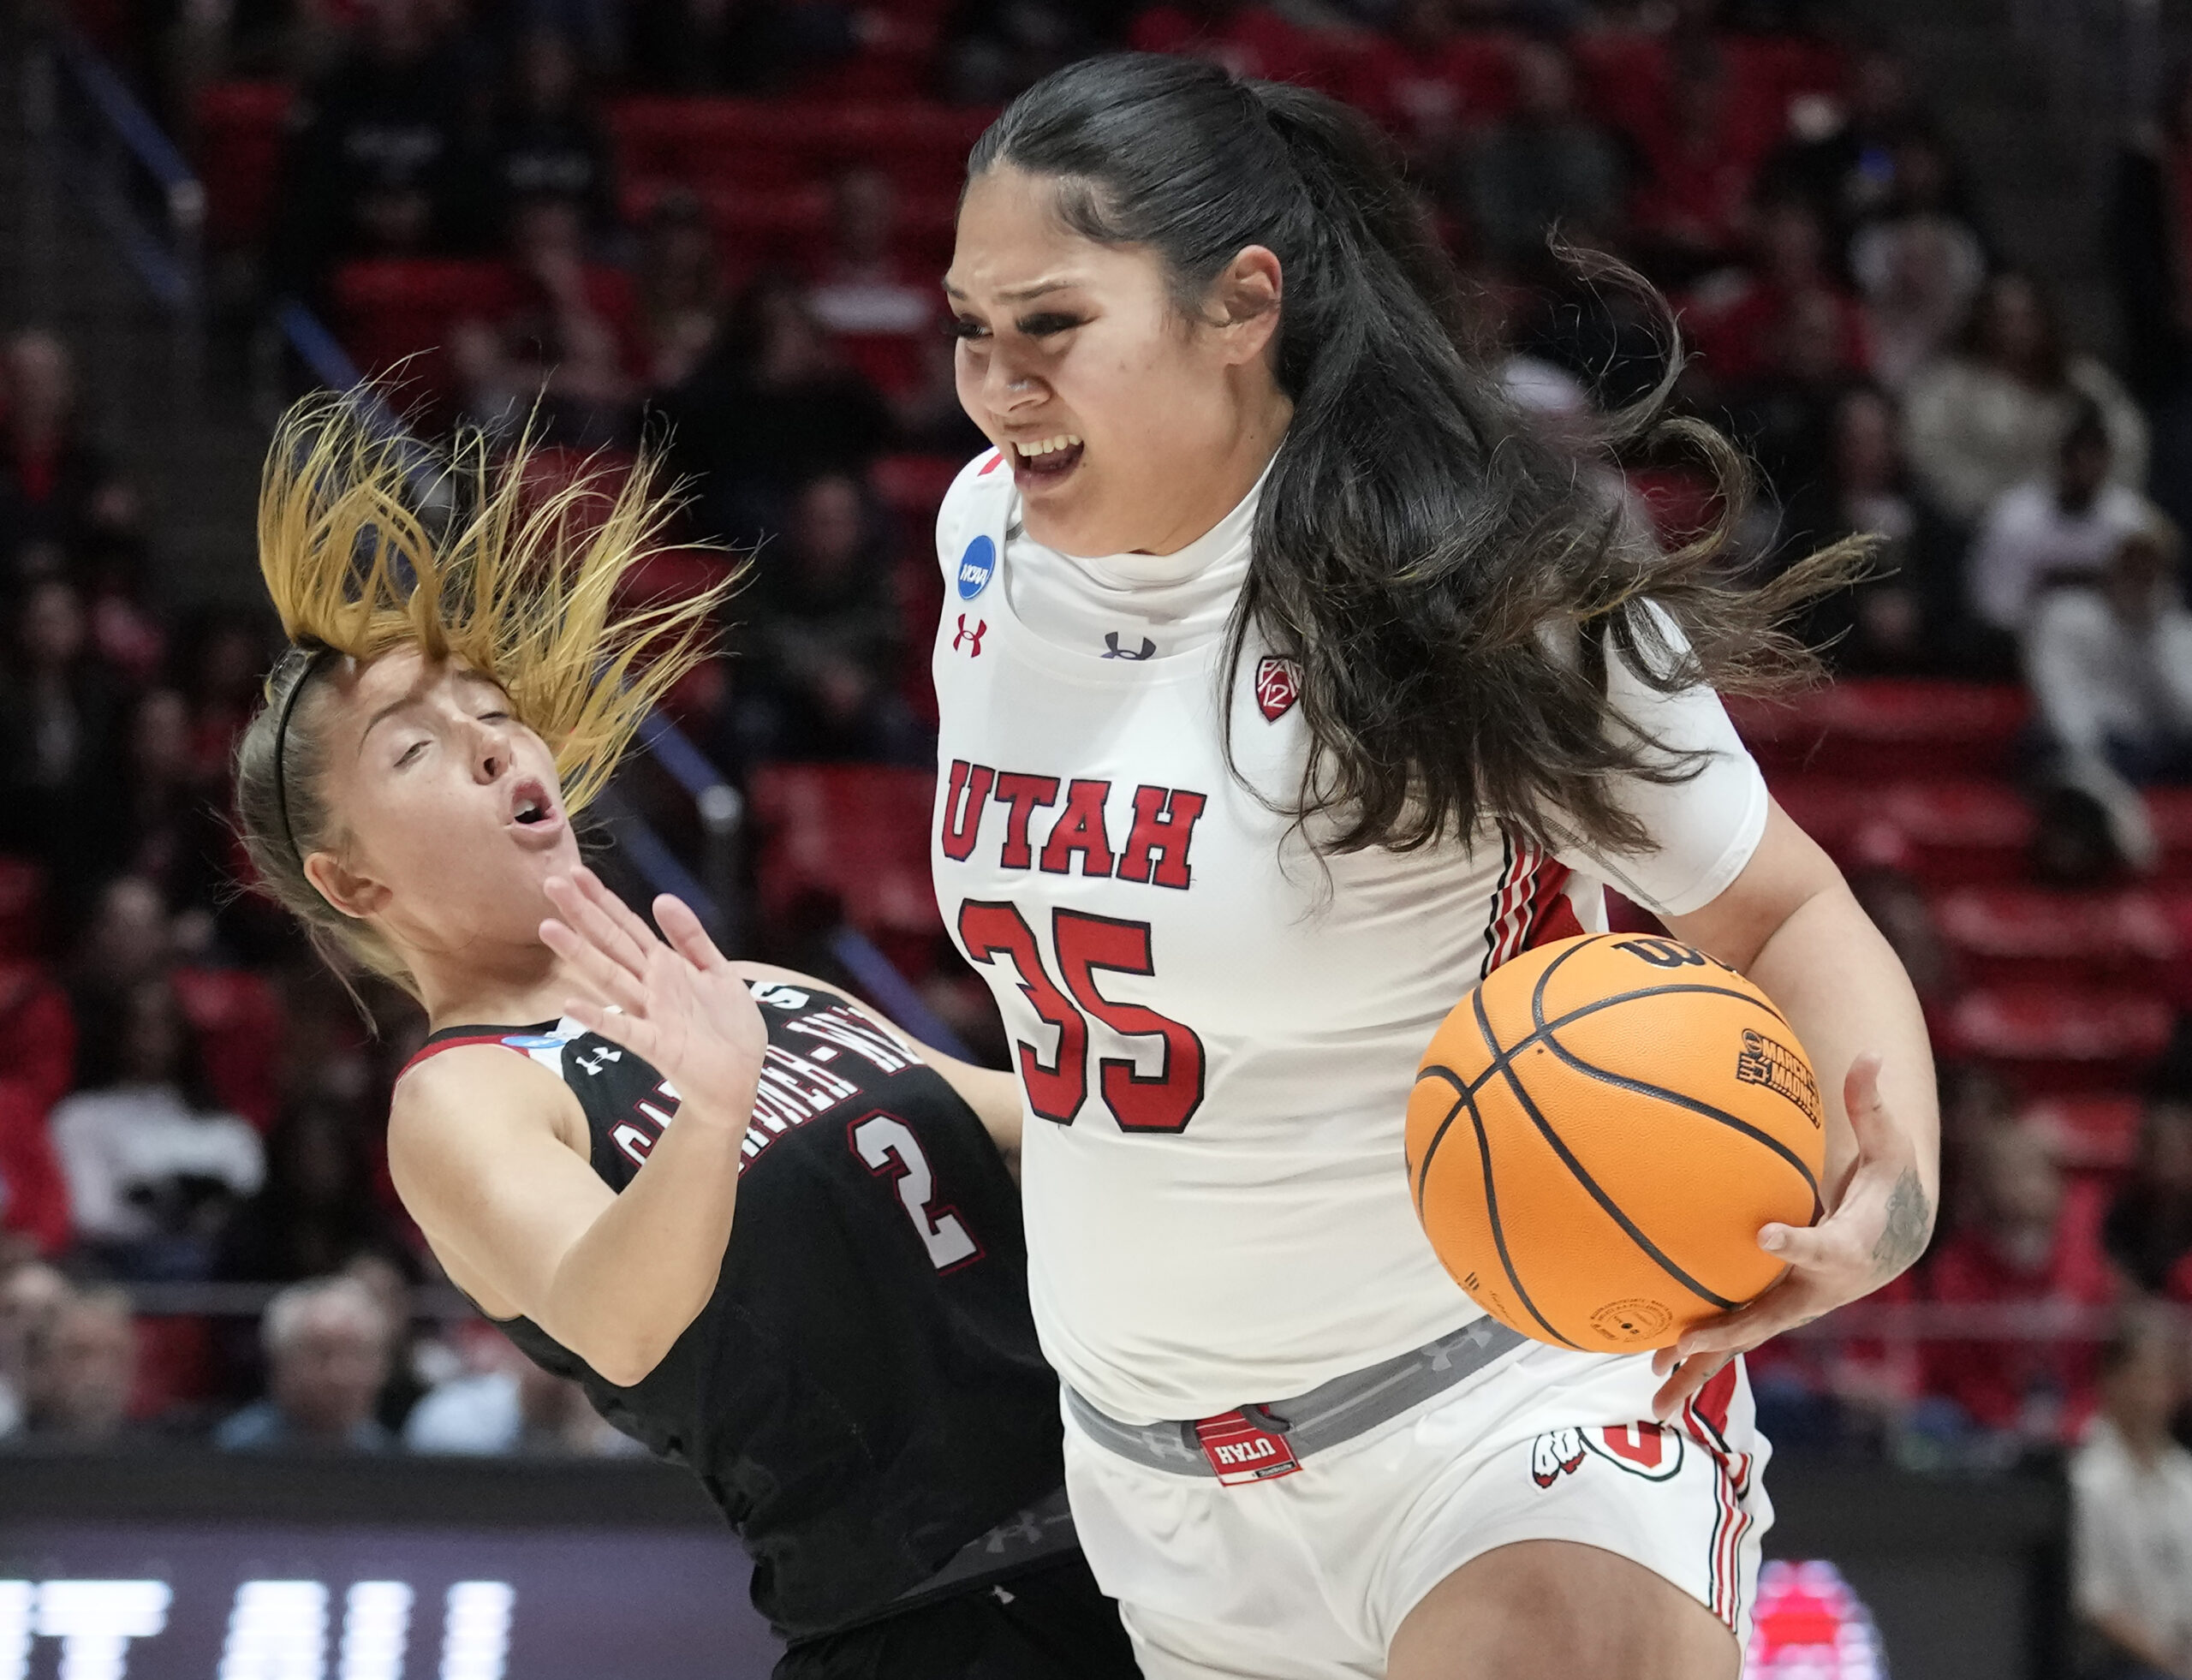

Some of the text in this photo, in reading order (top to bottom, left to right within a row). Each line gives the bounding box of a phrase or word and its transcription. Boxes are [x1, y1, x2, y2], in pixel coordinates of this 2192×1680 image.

[960, 563, 989, 587] NCAA
[1263, 683, 1287, 708] 12
[942, 760, 1207, 890] UTAH
[958, 898, 1206, 1133] 35
[1761, 1037, 1810, 1087] MARCH
[847, 1110, 986, 1275] 2
[1214, 1438, 1276, 1464] UTAH
